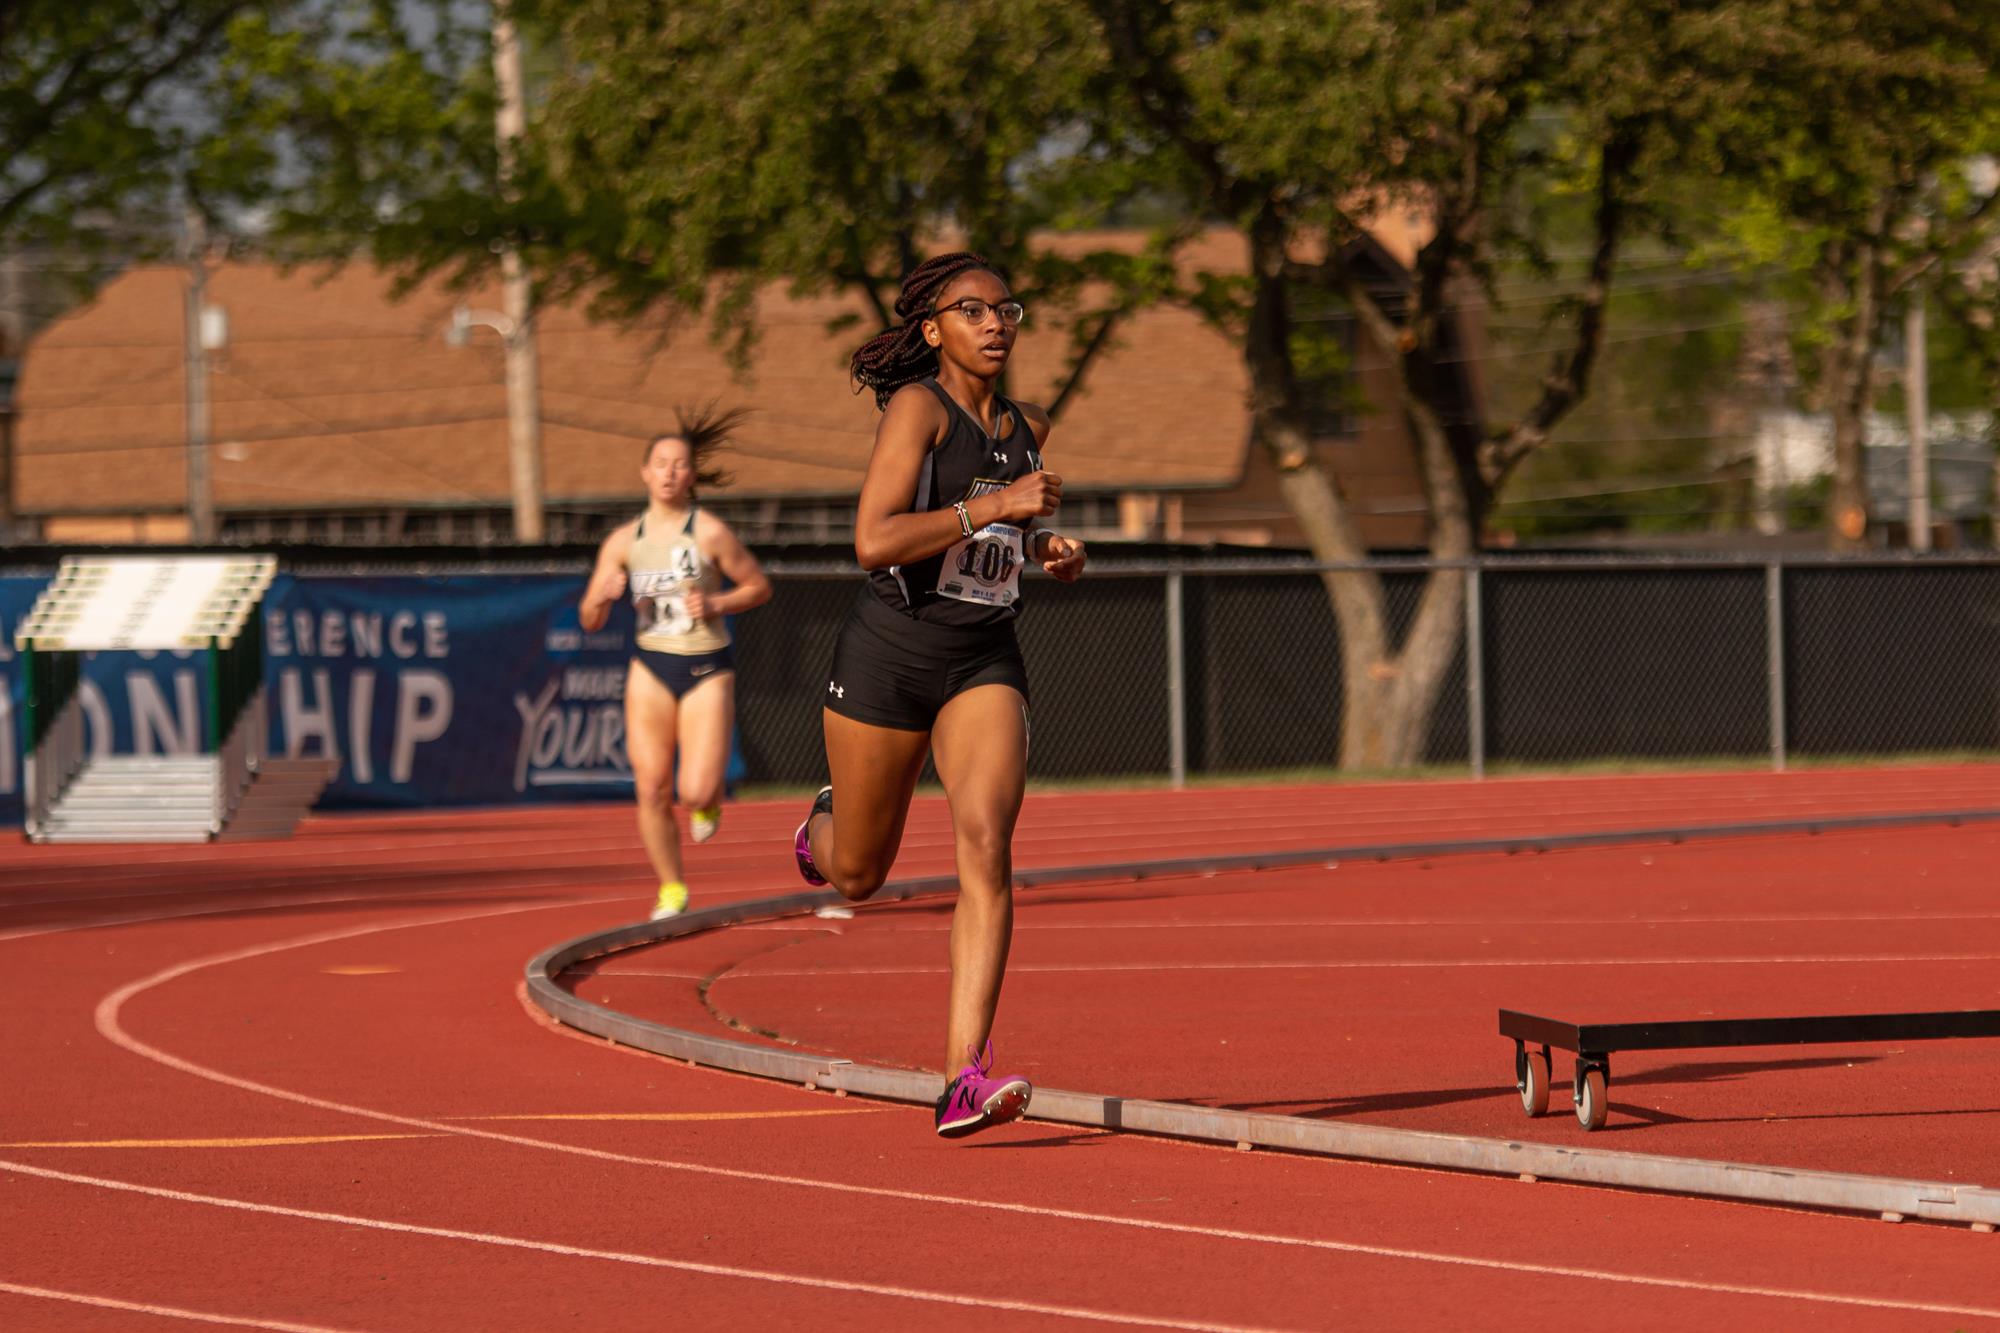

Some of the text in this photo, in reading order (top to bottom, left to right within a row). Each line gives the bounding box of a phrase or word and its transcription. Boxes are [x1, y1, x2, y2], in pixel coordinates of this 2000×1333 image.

[679, 548, 696, 577] 4
[958, 541, 1016, 583] 106
[513, 676, 630, 792] YOUR
[957, 1086, 978, 1111] N
